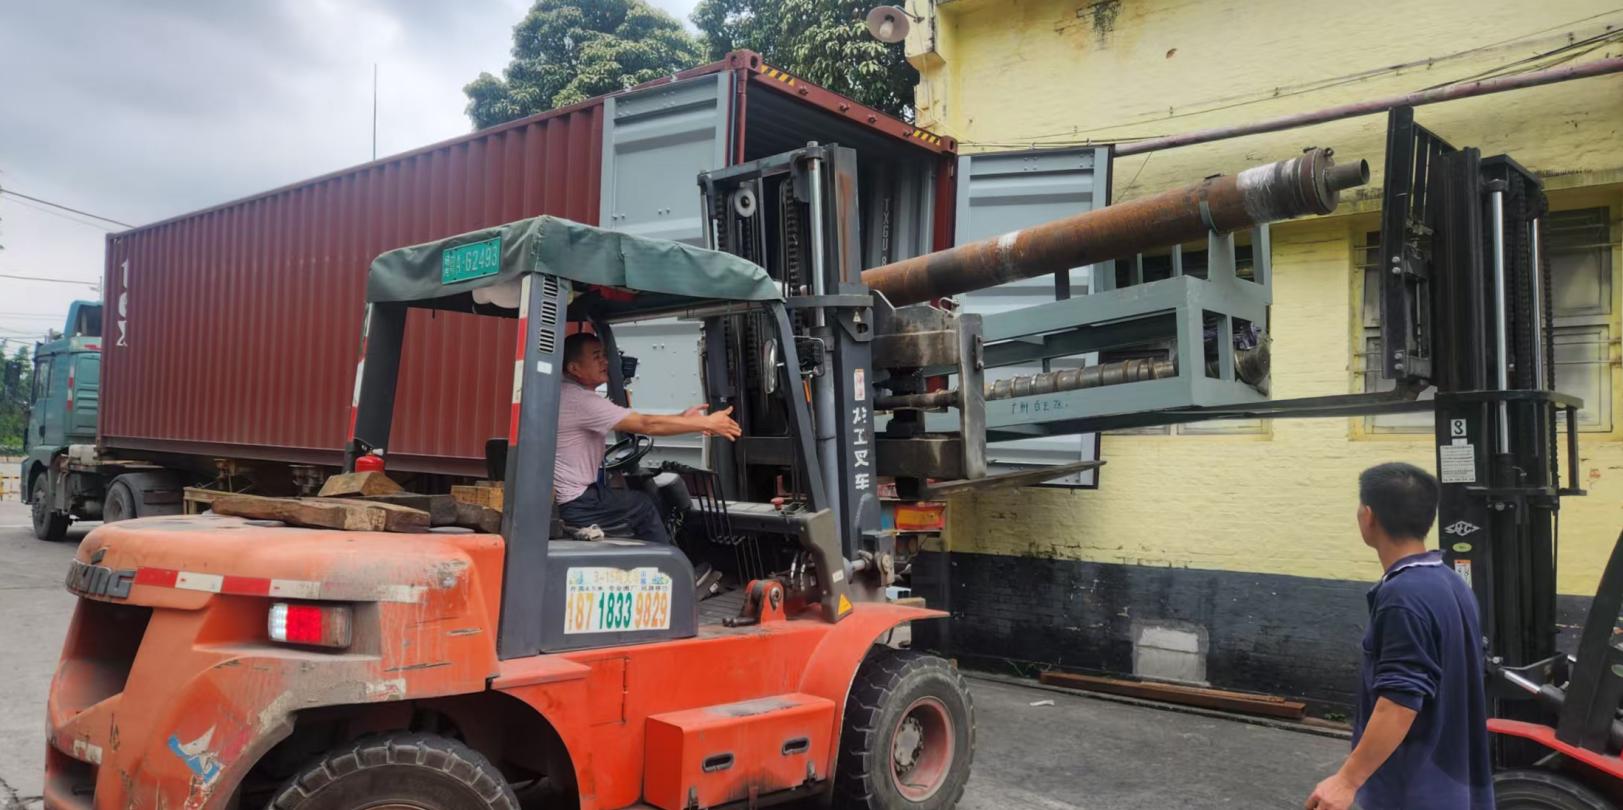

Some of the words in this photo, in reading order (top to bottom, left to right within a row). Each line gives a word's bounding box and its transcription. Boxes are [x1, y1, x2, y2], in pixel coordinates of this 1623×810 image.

[567, 592, 594, 631] 187
[599, 592, 632, 630] 1833
[634, 592, 668, 629] 9829
